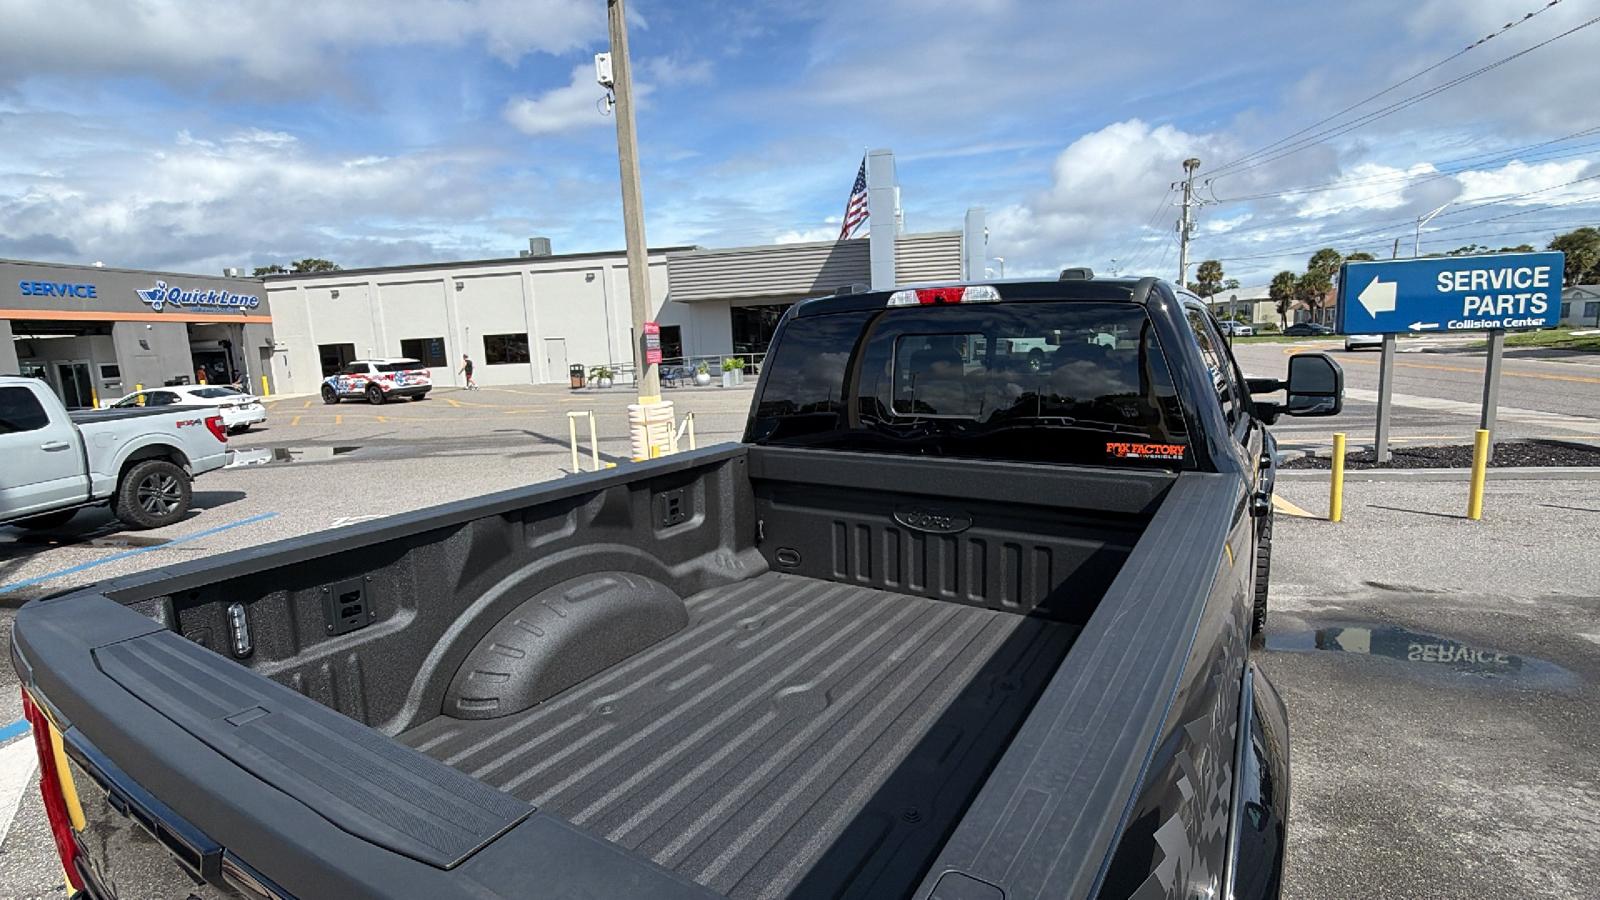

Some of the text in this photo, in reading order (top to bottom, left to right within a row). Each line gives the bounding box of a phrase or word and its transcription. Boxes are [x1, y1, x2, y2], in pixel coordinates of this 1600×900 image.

[1437, 266, 1550, 292] SERVICE
[19, 280, 97, 298] SERVICE
[1463, 292, 1547, 317] PARTS
[1447, 317, 1546, 330] Collision Center
[1106, 442, 1185, 455] FOX FACTORY
